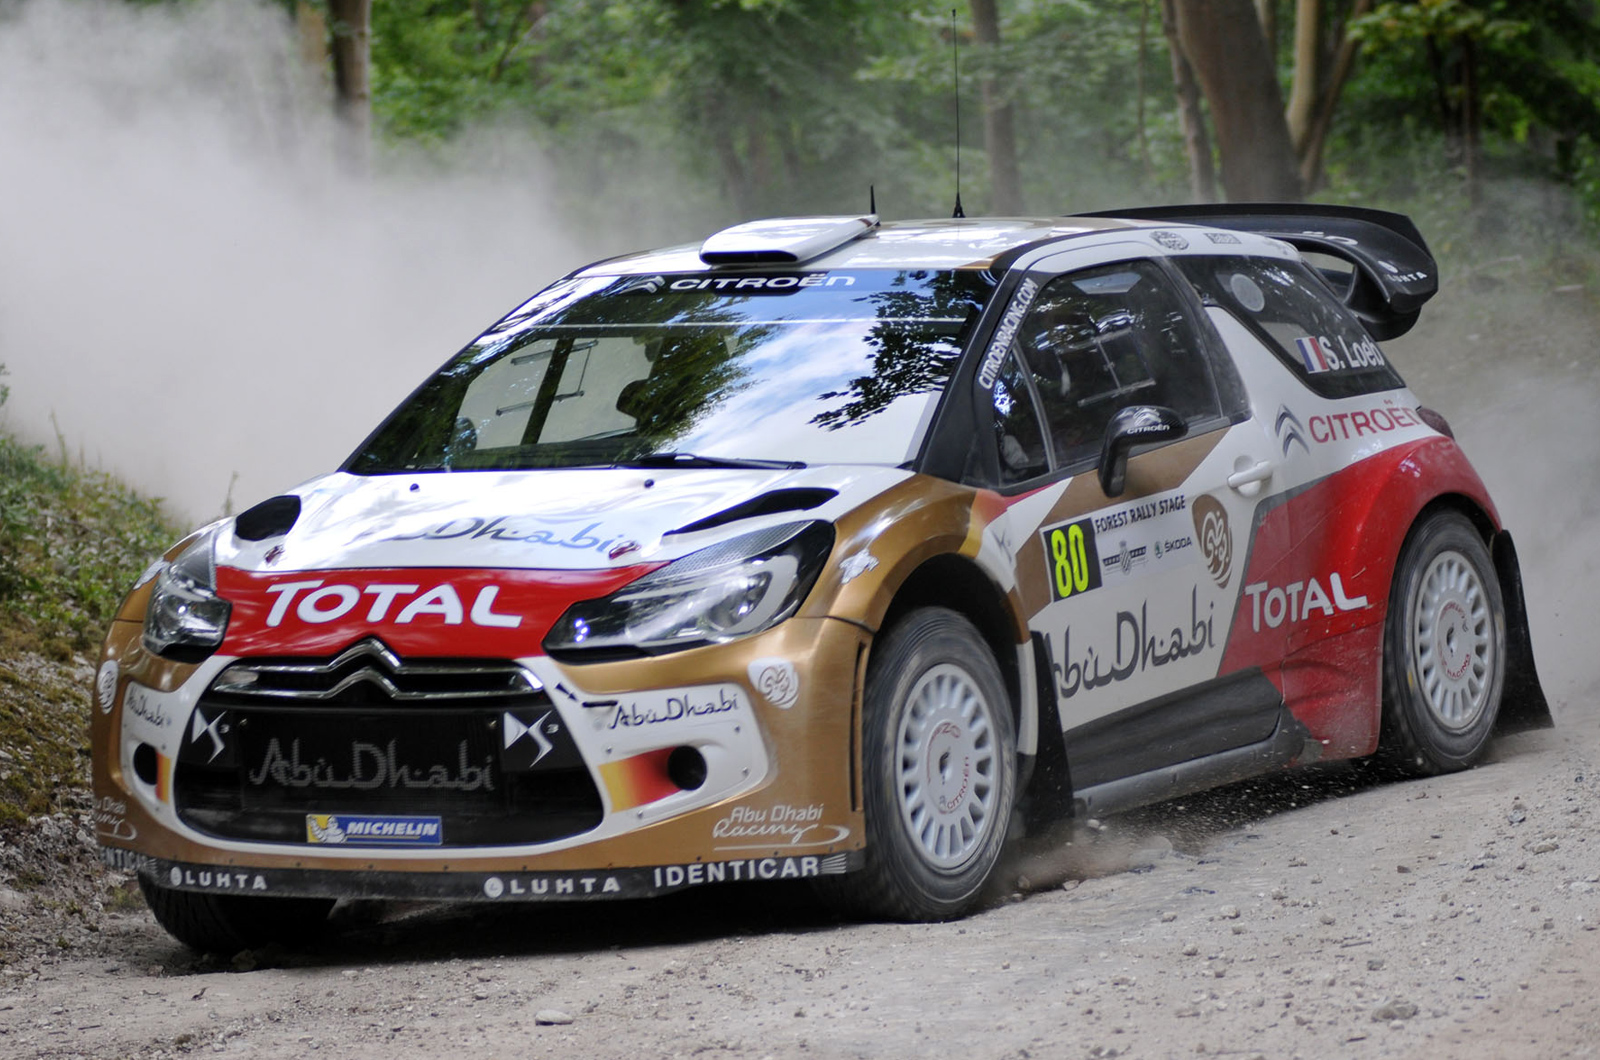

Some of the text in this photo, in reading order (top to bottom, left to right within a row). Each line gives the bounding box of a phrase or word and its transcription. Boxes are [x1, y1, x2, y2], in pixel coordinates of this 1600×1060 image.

[1318, 334, 1386, 371] S. Loeb
[1094, 494, 1187, 534] FOREST RALLY STAGE
[1050, 523, 1090, 598] 80
[265, 579, 523, 628] TOTAL
[1244, 572, 1368, 633] TOTAL
[345, 821, 438, 836] MICHELIN
[730, 803, 825, 824] Abu Dhabi
[712, 817, 819, 845] Racing
[184, 869, 268, 890] LUHTA
[510, 877, 622, 895] LUHTA
[653, 856, 819, 888] IDENTICAR
